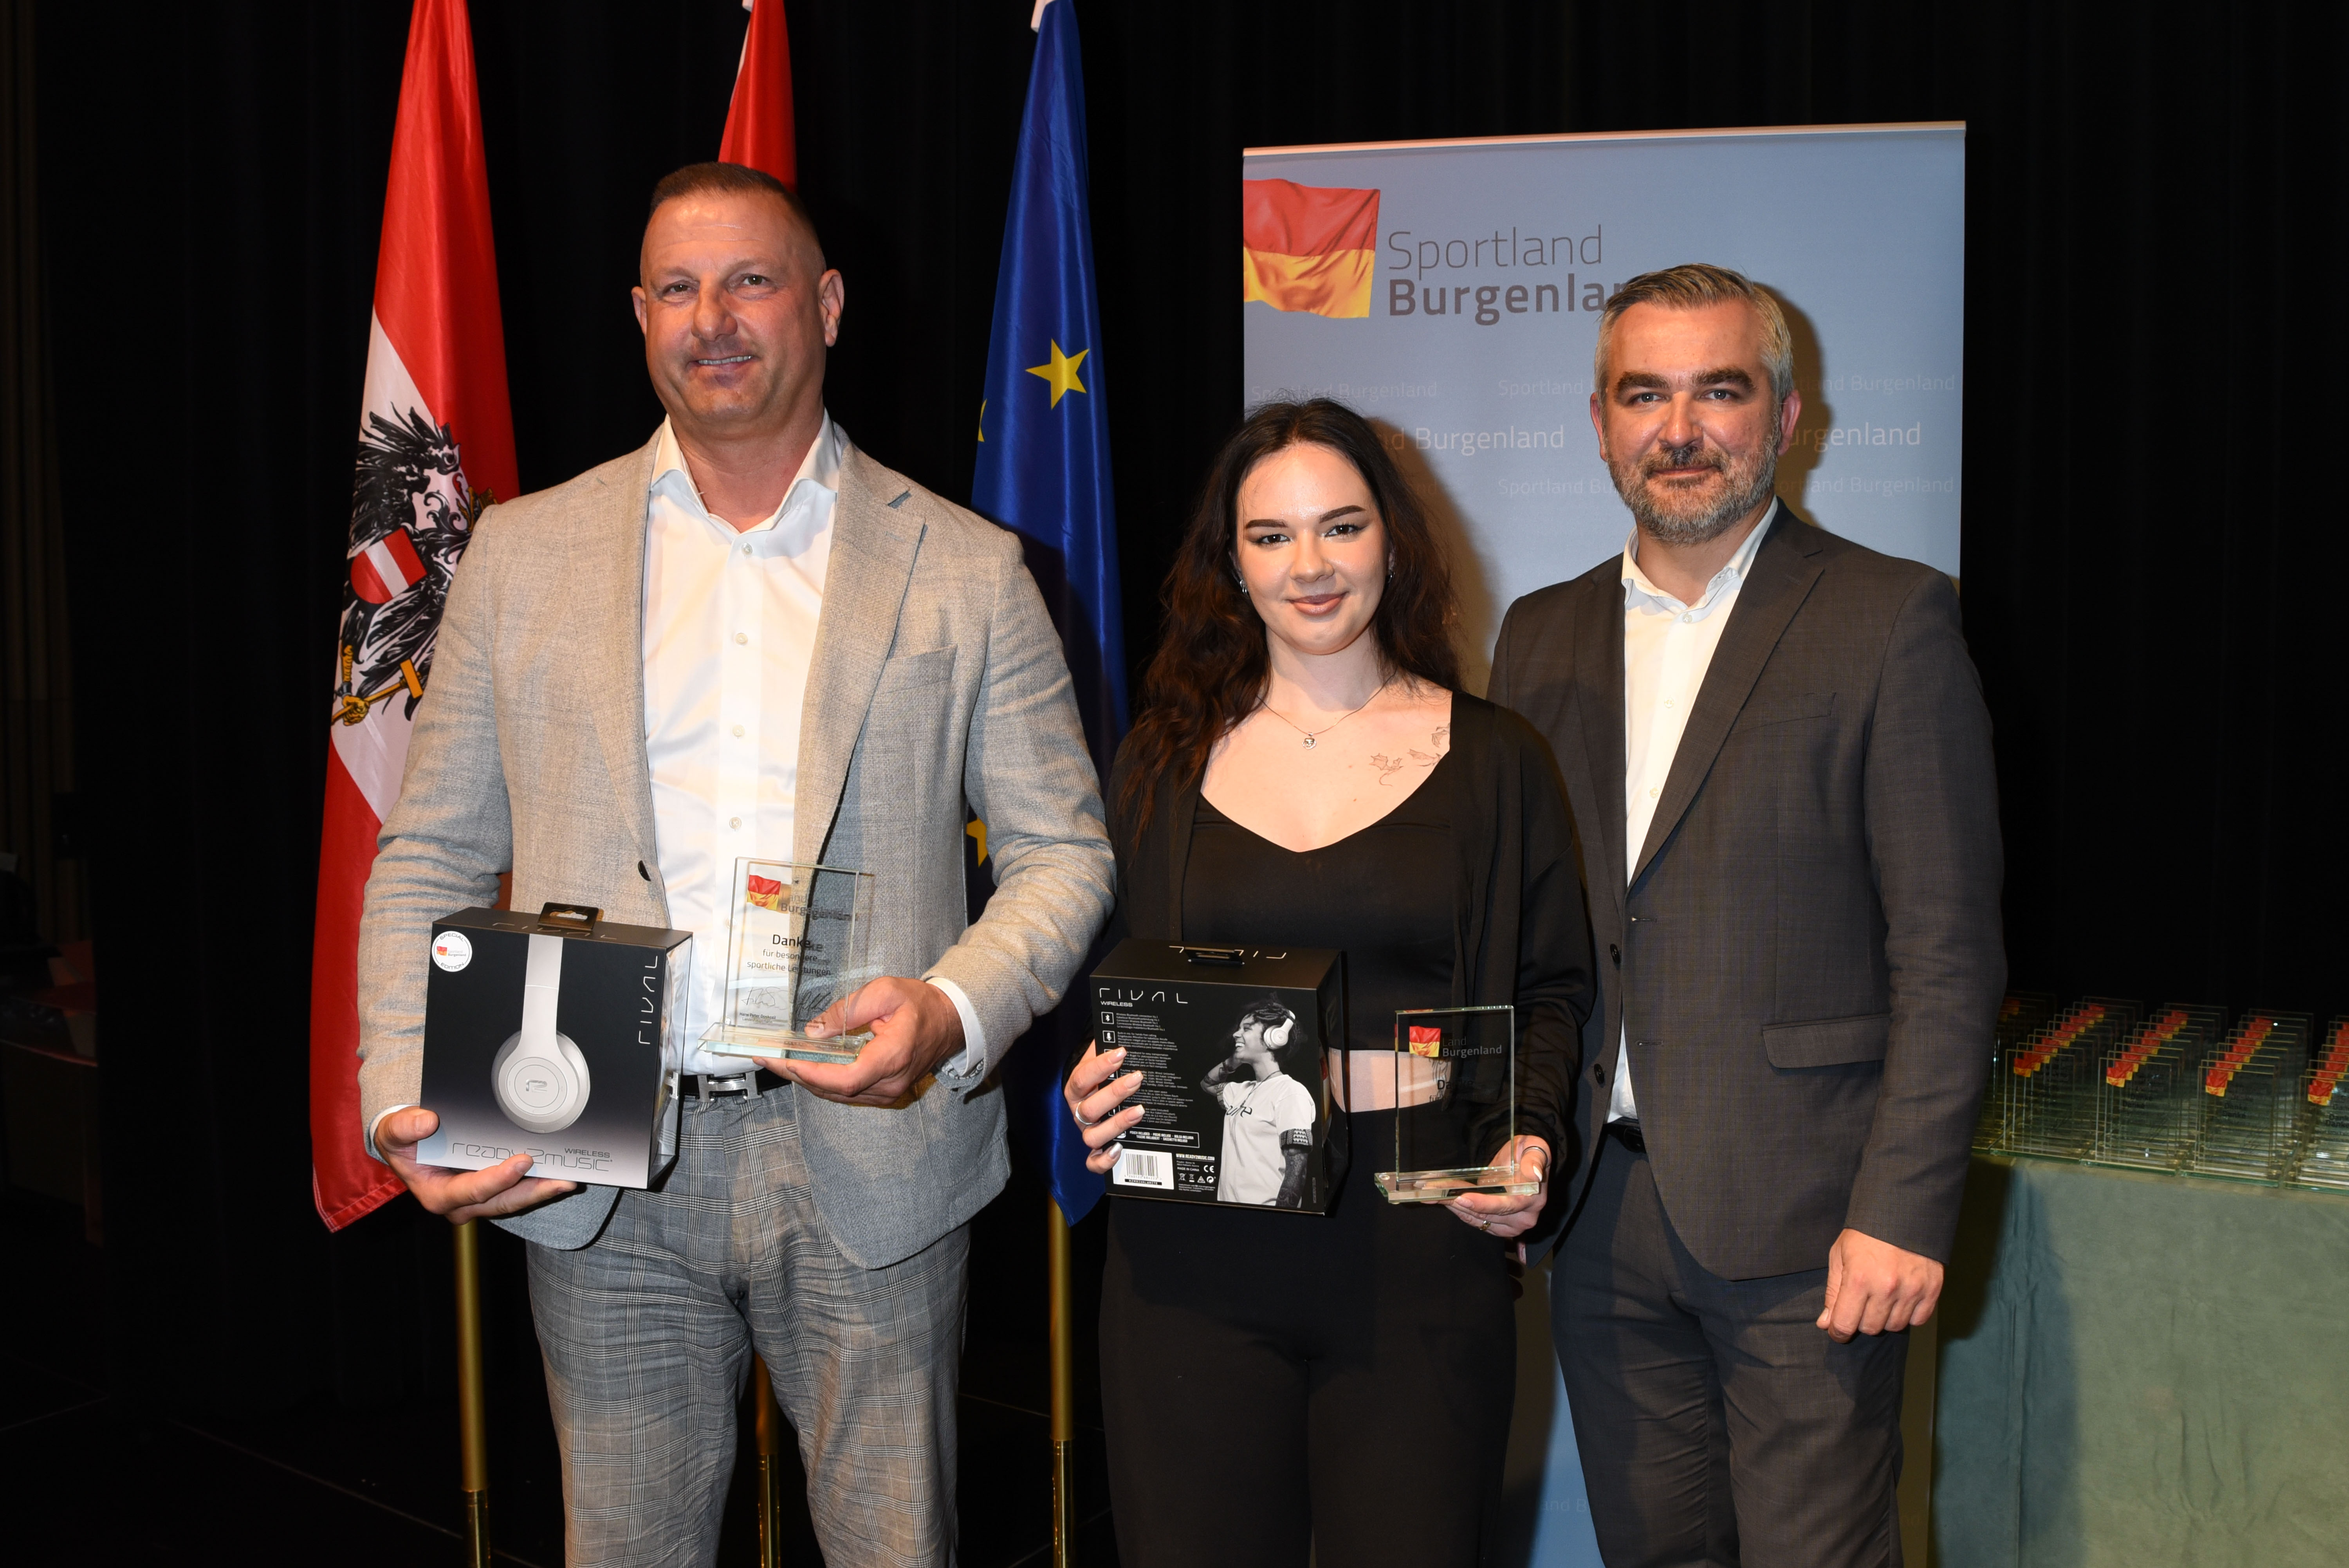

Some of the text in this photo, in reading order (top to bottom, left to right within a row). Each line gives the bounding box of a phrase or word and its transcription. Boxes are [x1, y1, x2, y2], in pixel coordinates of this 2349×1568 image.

[1388, 224, 1603, 280] Sportland
[1498, 379, 1583, 399] Sportland
[1851, 374, 1955, 394] Burgenland
[1416, 425, 1564, 457] Burgenland
[1498, 478, 1583, 498] Sportland
[1851, 477, 1954, 498] Burgenland
[439, 933, 464, 942] SPECIAL
[772, 934, 811, 948] Danke
[763, 949, 817, 962] für besonere
[440, 962, 465, 970] EDITION
[747, 962, 786, 971] sportliche
[1442, 1036, 1467, 1047] Land
[1442, 1044, 1502, 1059] Burgenland
[564, 1147, 611, 1158] WIRELESS
